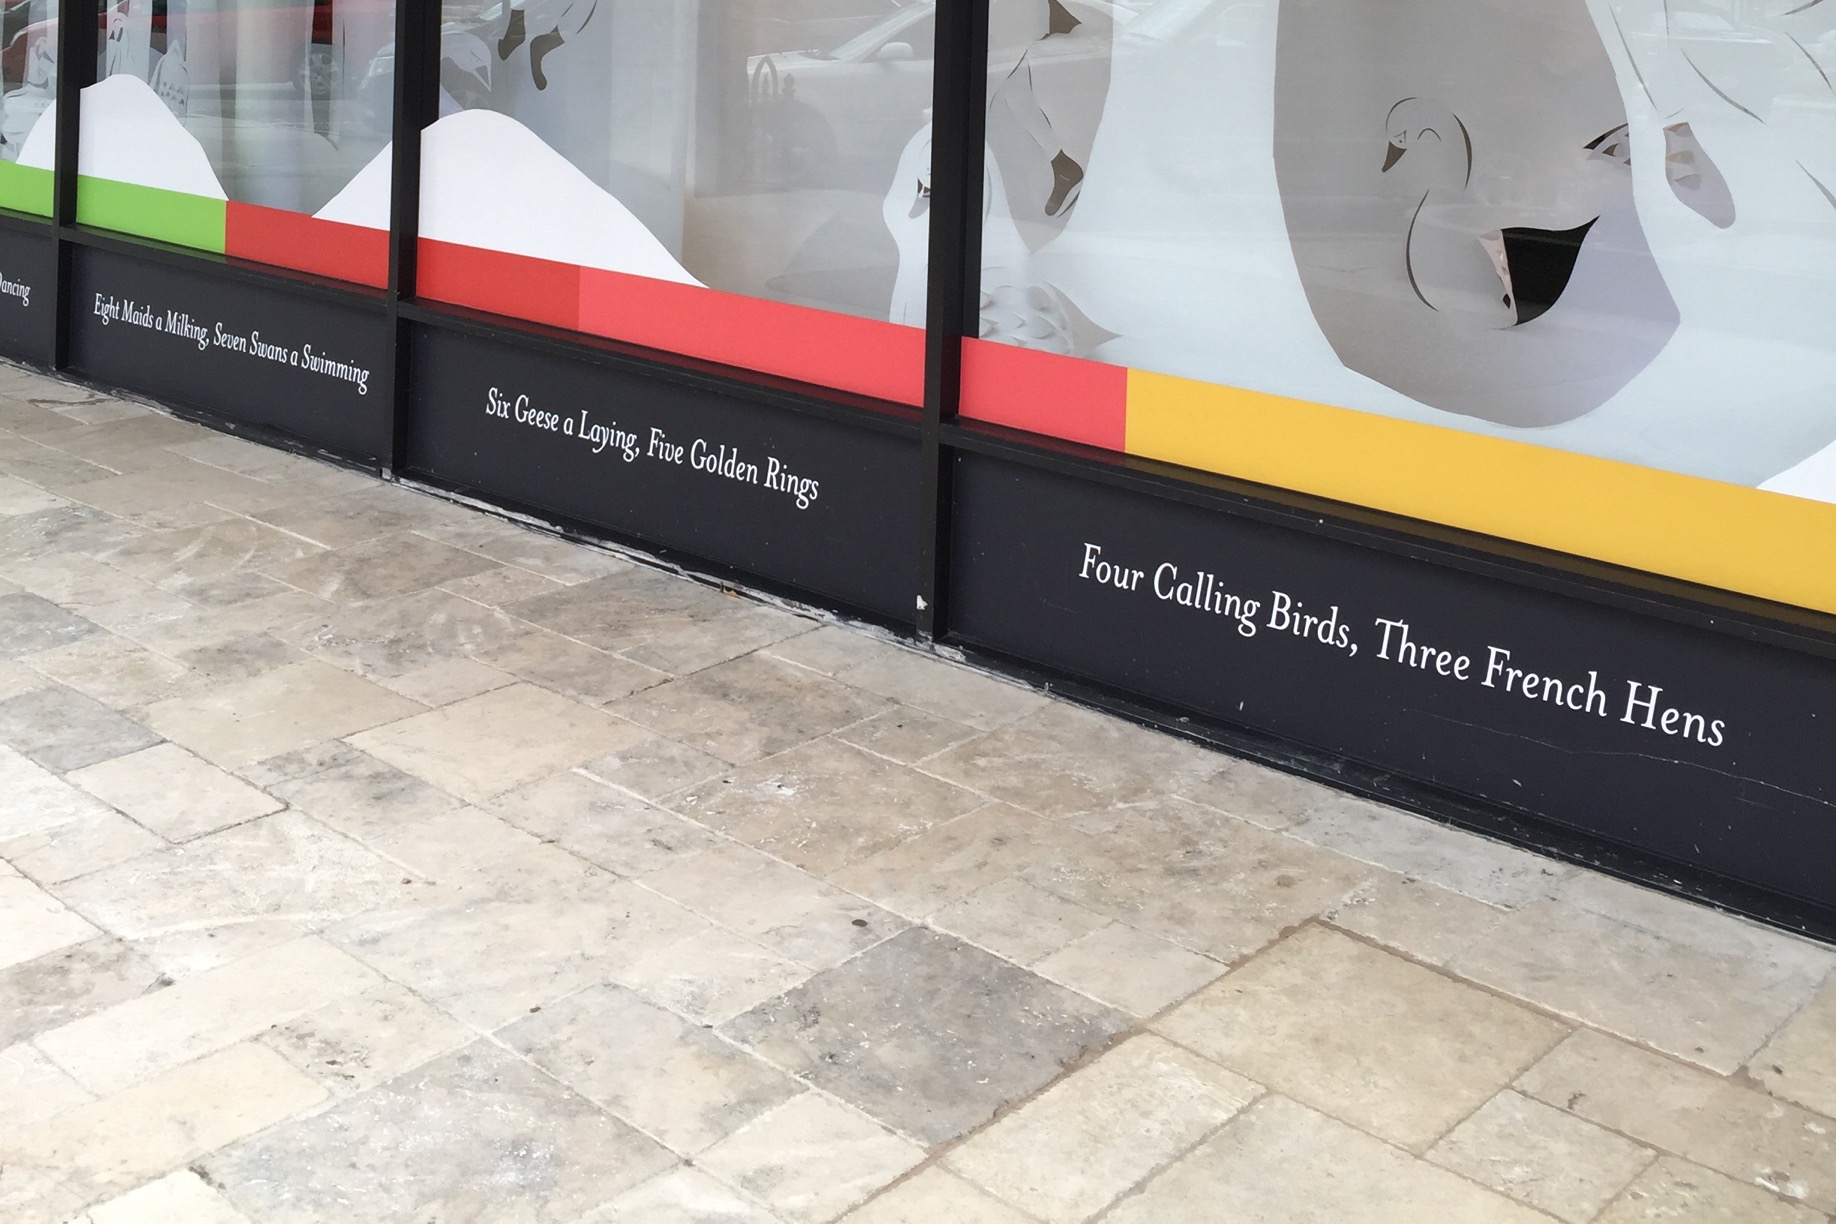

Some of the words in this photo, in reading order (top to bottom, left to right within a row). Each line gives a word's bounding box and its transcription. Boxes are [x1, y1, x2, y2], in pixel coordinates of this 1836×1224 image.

[0, 271, 31, 307] ancing
[93, 292, 120, 326] Eight
[120, 298, 154, 329] Maids
[154, 315, 163, 332] a
[164, 309, 210, 351] Milking,
[212, 321, 247, 353] Seven
[248, 330, 289, 365] Swans
[289, 349, 299, 368] a
[300, 343, 370, 396] Swimming
[485, 386, 512, 420] Six
[514, 394, 560, 433] Geese
[563, 417, 574, 437] a
[577, 409, 641, 464] Laying,
[646, 426, 685, 465] Five
[690, 438, 759, 485] Golden
[763, 456, 821, 511] Rings
[1078, 542, 1145, 592] Four
[1153, 562, 1261, 638] Calling
[1266, 590, 1359, 658] Birds,
[1374, 617, 1471, 681] Three
[1480, 645, 1608, 717] French
[1619, 679, 1726, 747] Hens
